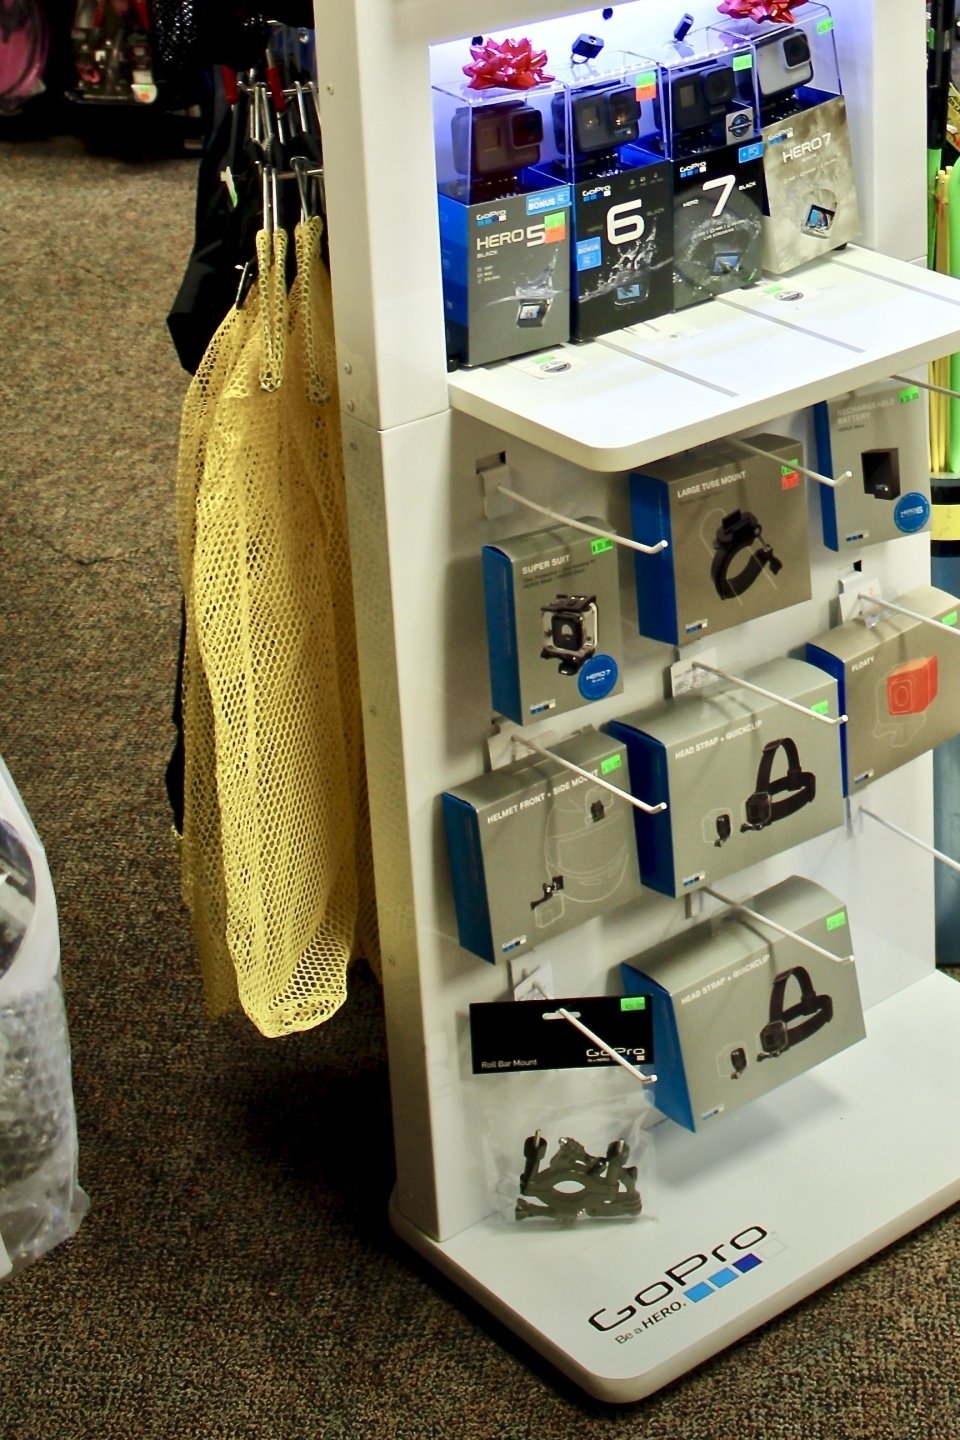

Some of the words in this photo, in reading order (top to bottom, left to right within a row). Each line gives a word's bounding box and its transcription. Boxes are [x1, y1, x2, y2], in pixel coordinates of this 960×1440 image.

[702, 174, 736, 217] 7
[739, 181, 757, 191] BLACK
[528, 197, 556, 211] BONUS
[606, 199, 645, 245] 6
[476, 250, 498, 259] BLACK
[837, 412, 871, 425] BATTERY
[677, 485, 701, 498] LARGE
[702, 478, 720, 491] TUBE
[721, 471, 747, 485] MOUNT
[522, 560, 550, 575] SUPER
[551, 554, 571, 567] SUIT
[851, 656, 875, 672] FLOATY
[675, 746, 695, 760] HEAD
[695, 736, 719, 752] STRAP
[725, 719, 763, 741] QUICKCLIP
[487, 805, 518, 824] HELMET
[519, 792, 546, 812] FRONT
[553, 781, 570, 796] SIDE
[571, 768, 599, 787] MOT
[681, 990, 702, 1005] HEAD
[702, 977, 726, 995] STRAP
[732, 953, 770, 980] QUICKCLIP
[481, 1060, 497, 1069] Roll
[498, 1060, 512, 1068] Bar
[513, 1058, 538, 1067] Mount
[588, 1225, 768, 1332] GoPro
[614, 1331, 634, 1345] Be
[634, 1326, 644, 1335] a
[641, 1300, 687, 1330] HERO.
